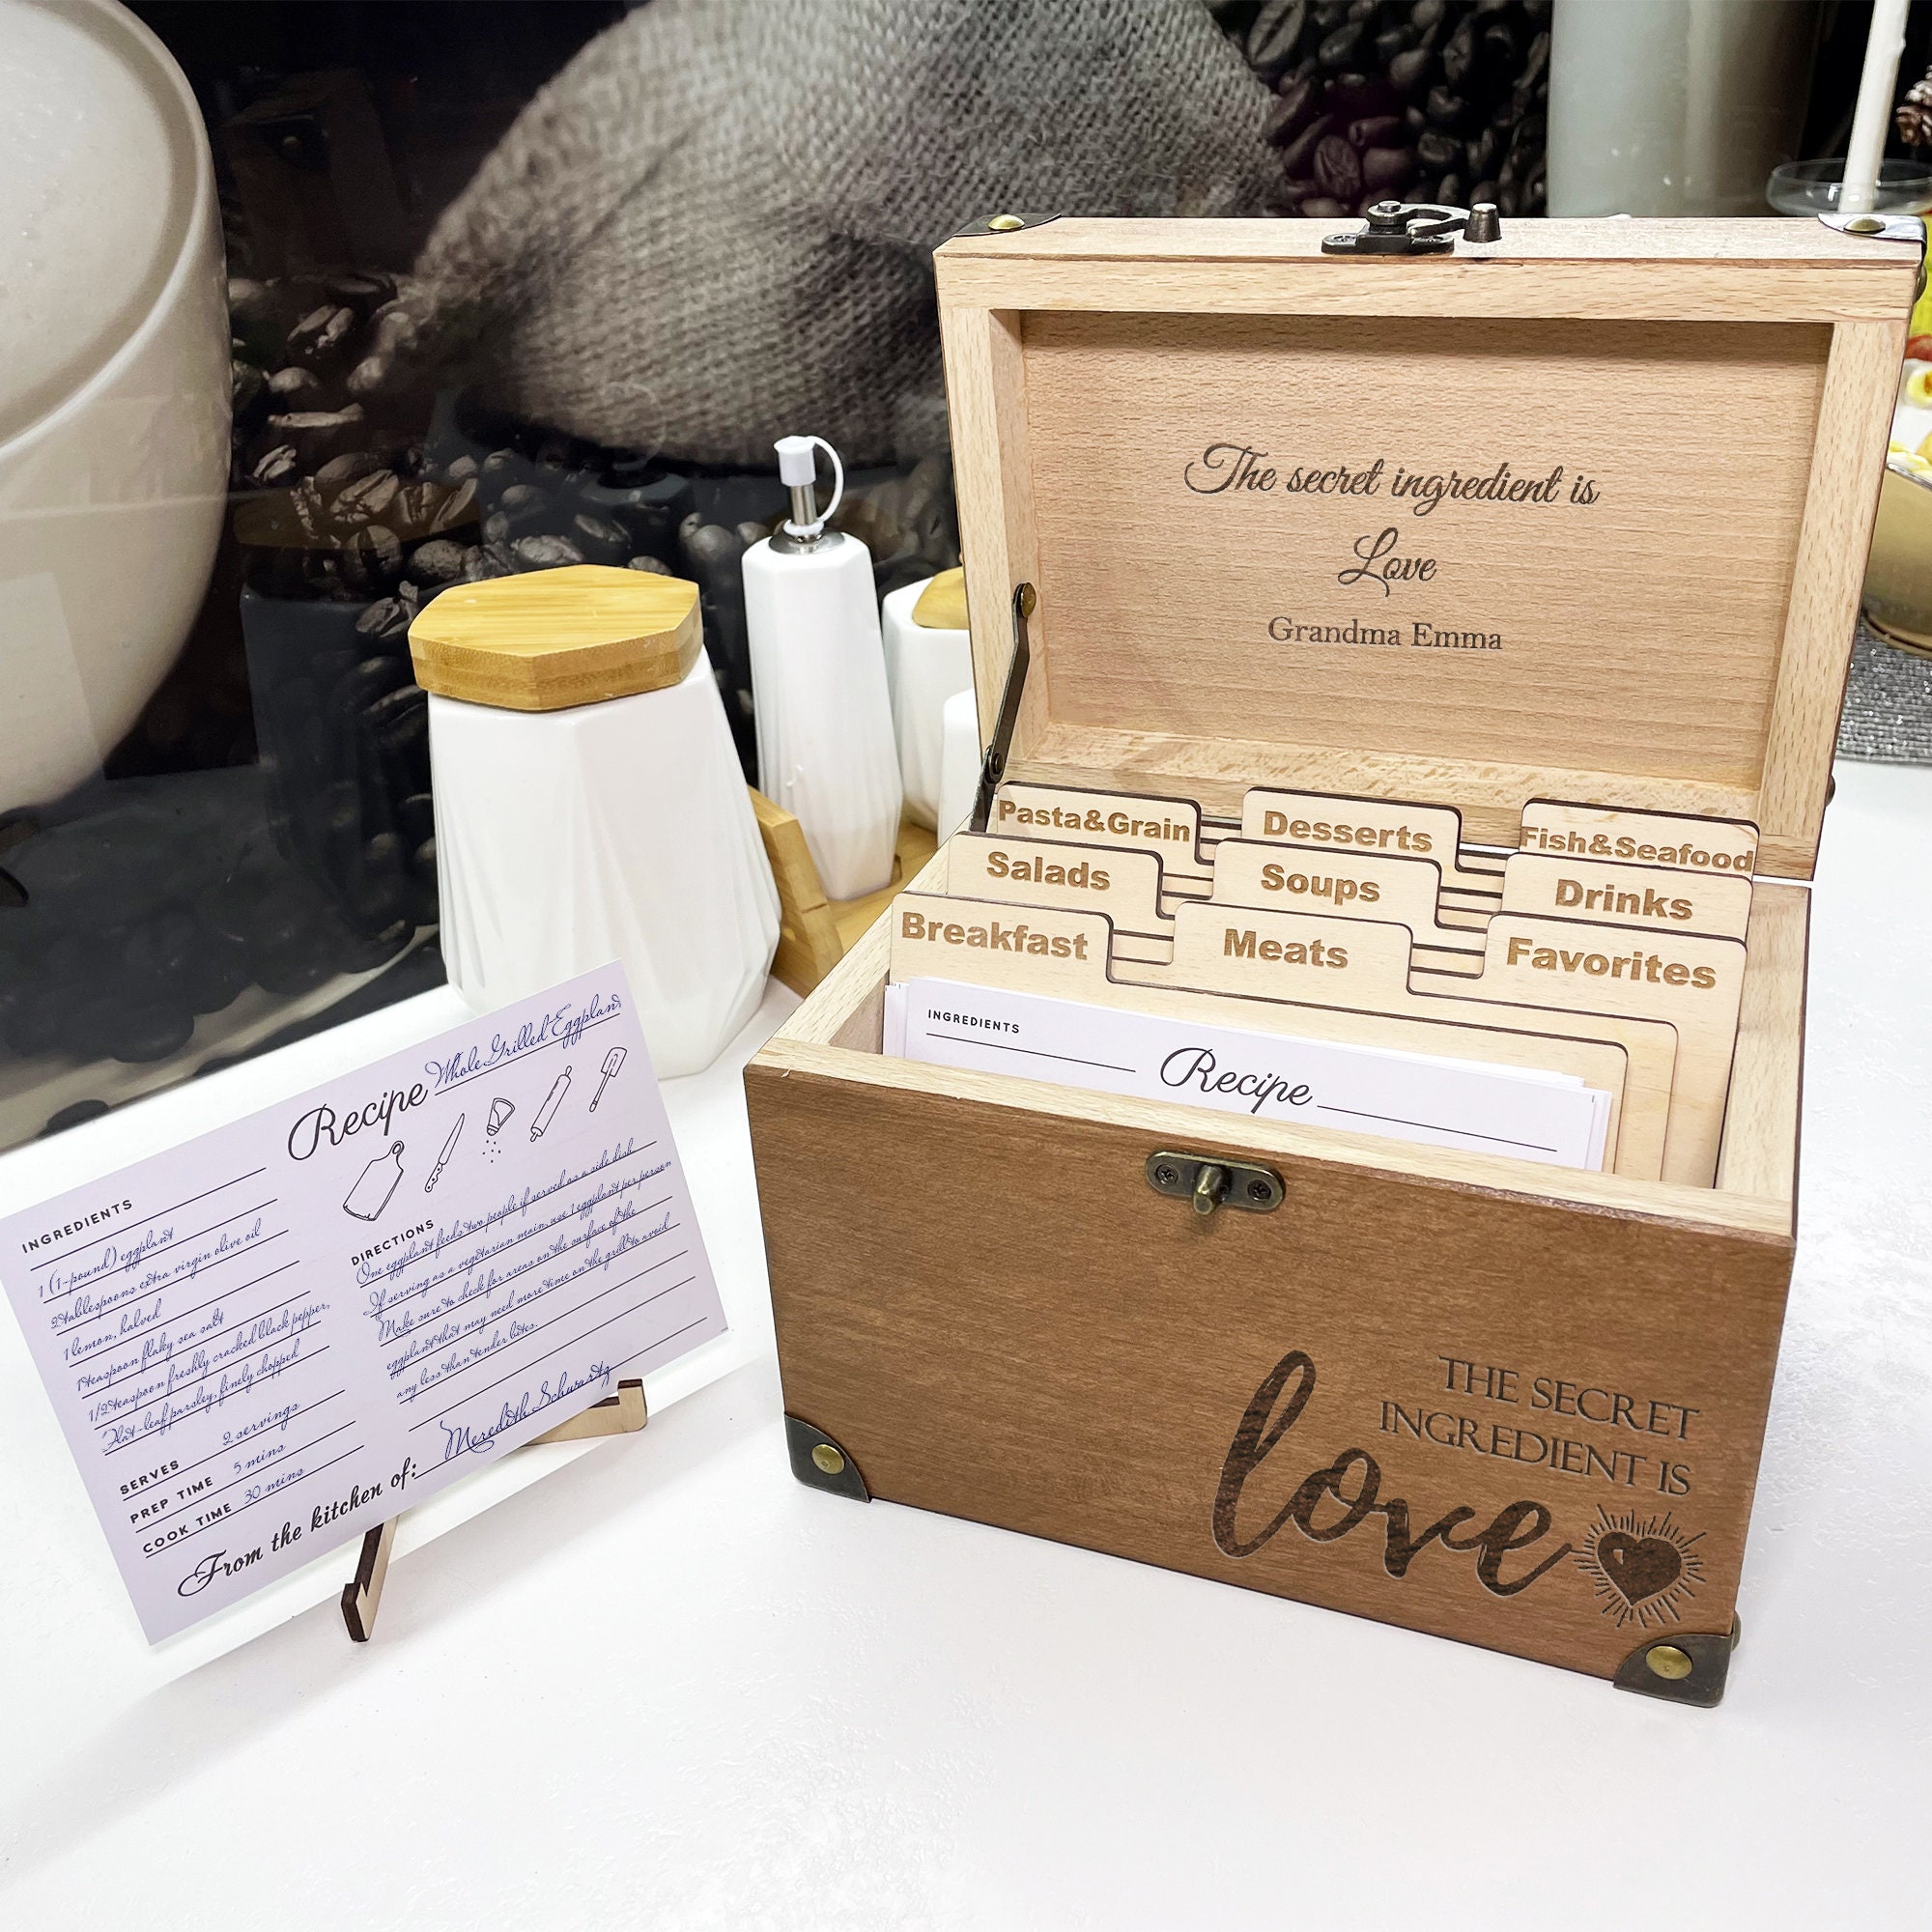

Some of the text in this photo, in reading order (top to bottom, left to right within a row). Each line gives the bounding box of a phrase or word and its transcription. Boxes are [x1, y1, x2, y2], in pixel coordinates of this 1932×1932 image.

[1183, 442, 1601, 517] The secret ingredient is
[1337, 526, 1438, 598] Love
[1267, 616, 1503, 651] Grandma Emma
[997, 800, 1191, 843] Pasta&Grain
[1263, 810, 1434, 853] Desserts
[1519, 826, 1755, 872] Fish&Seafood
[985, 851, 1112, 892] Salads
[1260, 863, 1381, 906] Soups
[1554, 879, 1694, 922] Drinks
[901, 911, 1090, 962] Breakfast
[1223, 928, 1350, 970] Meats
[1506, 936, 1718, 990] Favorites
[927, 1009, 1021, 1035] INGREDIENTS
[287, 1083, 429, 1161] Recipe
[424, 1046, 484, 1089] Whole
[484, 1013, 549, 1066] Grilled
[1159, 1046, 1314, 1115] Recipe
[21, 1199, 133, 1254] INGREDIENTS
[120, 1227, 174, 1273] eggplant
[351, 1219, 435, 1266] DIRECTIONS
[355, 1261, 385, 1285] One
[385, 1238, 435, 1281] eggplant
[435, 1220, 464, 1259] feeds
[485, 1194, 517, 1233] people
[520, 1186, 530, 1217] if
[531, 1169, 566, 1202] served
[589, 1150, 609, 1173] side
[362, 1289, 386, 1321] If
[387, 1278, 430, 1300] serving
[459, 1237, 514, 1275] vegetarian
[550, 1210, 568, 1224] use
[576, 1181, 620, 1220] eggplant
[620, 1178, 637, 1199] per
[139, 1271, 171, 1290] extra
[173, 1252, 213, 1280] virgin
[214, 1233, 242, 1256] olive
[244, 1217, 262, 1241] oil
[378, 1311, 415, 1341] Make
[418, 1305, 442, 1321] sure
[457, 1273, 485, 1302] check
[486, 1268, 503, 1298] for
[506, 1260, 533, 1277] areas
[536, 1252, 551, 1263] on
[549, 1235, 568, 1254] the
[571, 1219, 607, 1248] surface
[609, 1207, 621, 1235] of
[120, 1297, 162, 1335] halved
[386, 1338, 435, 1379] eggplant
[463, 1315, 487, 1335] may
[490, 1290, 515, 1318] need
[517, 1287, 544, 1304] more
[572, 1265, 585, 1276] on
[584, 1248, 603, 1267] the
[641, 1211, 670, 1240] avoid
[140, 1332, 174, 1374] flaky
[177, 1332, 196, 1345] sea
[199, 1307, 225, 1334] salt
[167, 1350, 211, 1397] freshly
[213, 1323, 257, 1363] cracked
[258, 1309, 290, 1340] black
[218, 1363, 254, 1406] finely
[256, 1338, 300, 1379] chopped
[396, 1383, 417, 1403] any
[420, 1367, 442, 1385] less
[441, 1352, 470, 1374] than
[469, 1330, 508, 1356] tender
[1438, 1354, 1701, 1440] THE SECRET
[120, 1402, 301, 1495] SERVES 2 servings
[1211, 1350, 1577, 1598] love
[1379, 1400, 1692, 1496] INGREDIENT IS
[129, 1444, 287, 1524] PREP TIME 5 mins
[143, 1467, 305, 1553] COOK TIME 30 mins
[177, 1547, 264, 1597] From
[270, 1521, 302, 1552] the
[310, 1484, 383, 1532] kitchen
[390, 1457, 417, 1489] of:
[440, 1391, 530, 1460] Meredith
